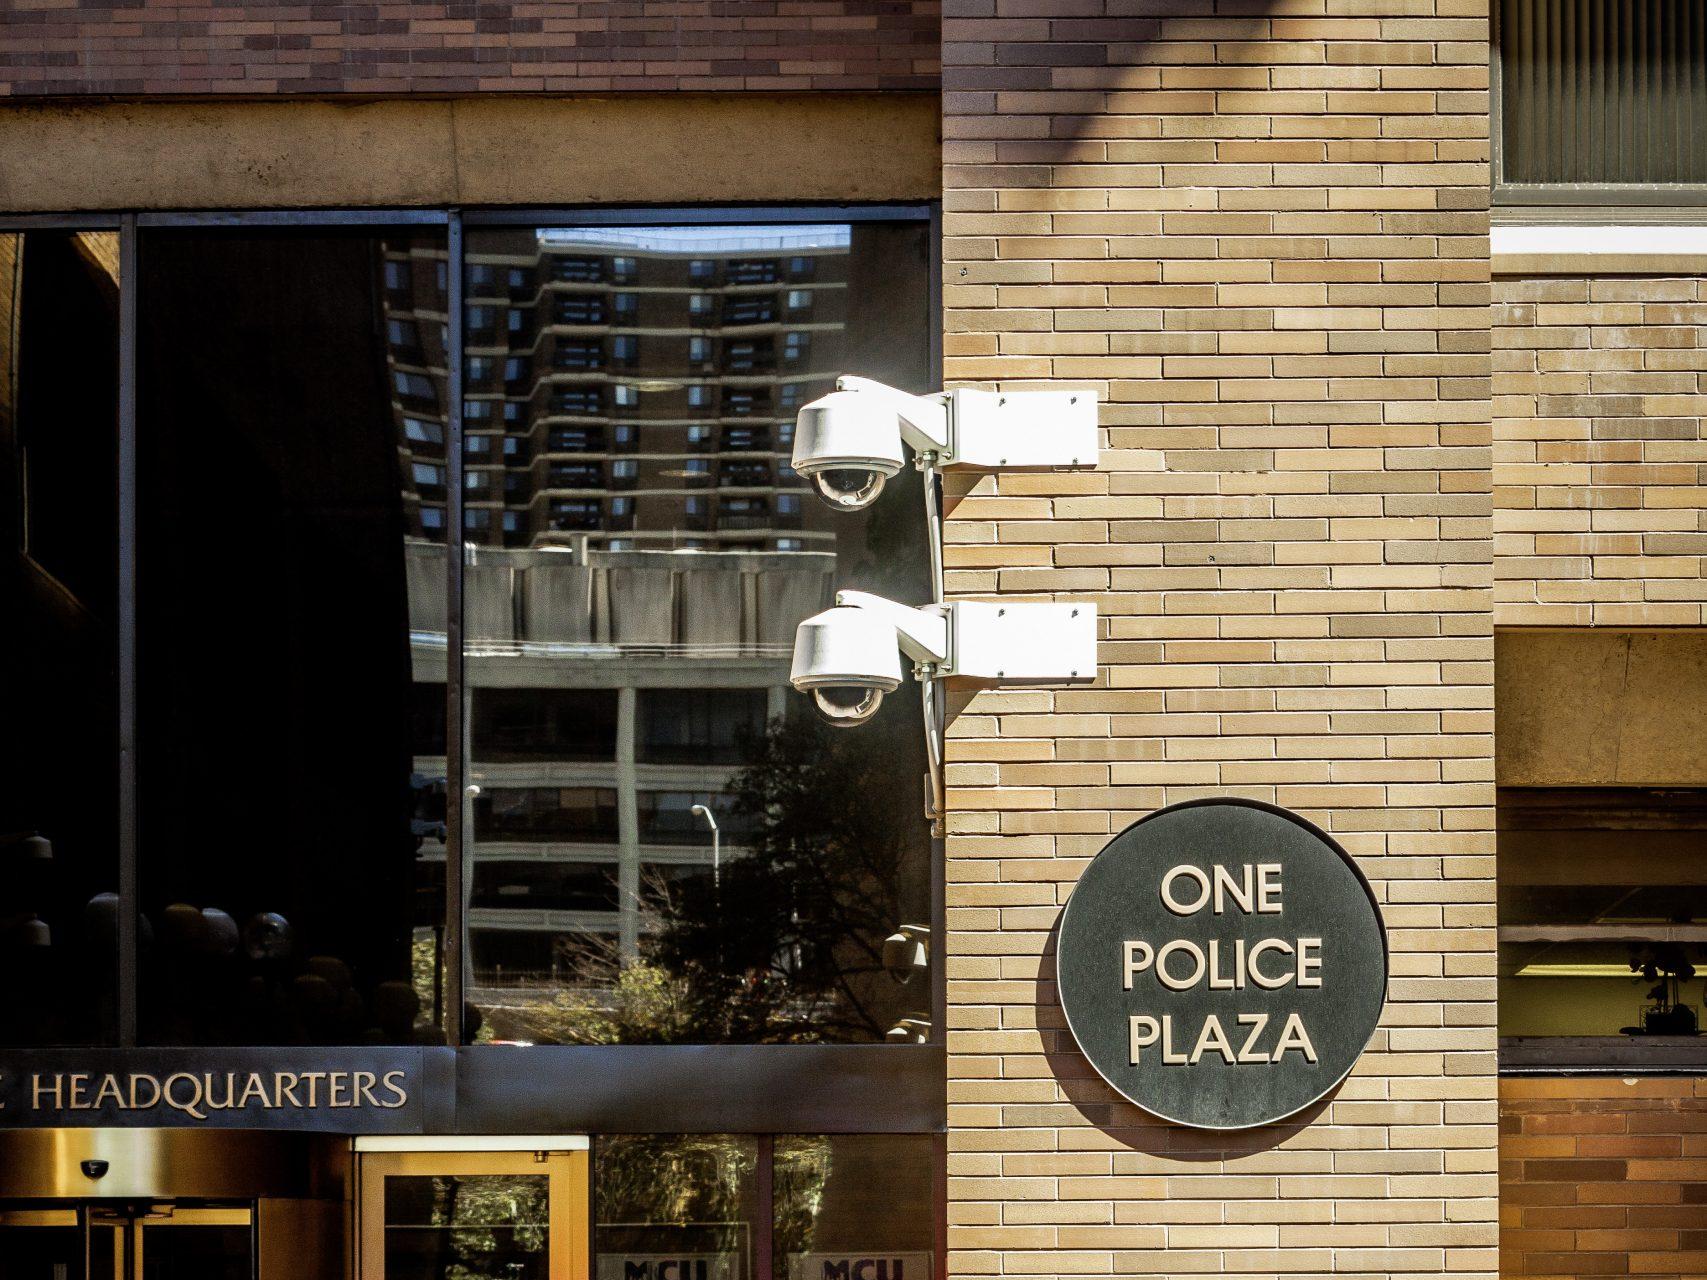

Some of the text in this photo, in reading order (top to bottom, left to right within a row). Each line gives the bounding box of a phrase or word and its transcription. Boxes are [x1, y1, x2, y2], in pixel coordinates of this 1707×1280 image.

[1160, 863, 1283, 916] ONE
[1122, 938, 1322, 991] POLICE
[1129, 1013, 1318, 1066] PLAZA
[32, 1071, 407, 1118] HEADQUARTERS
